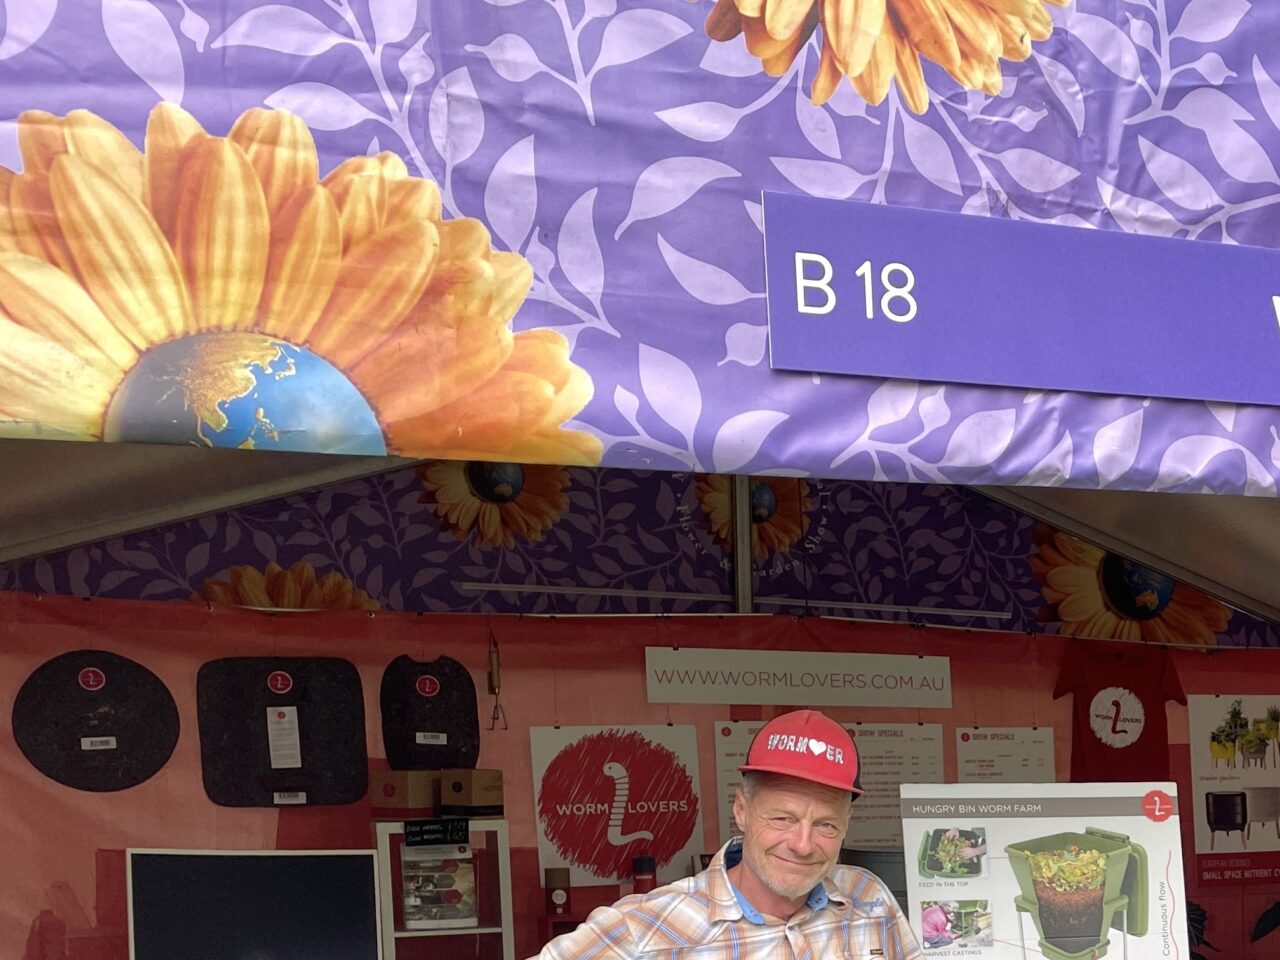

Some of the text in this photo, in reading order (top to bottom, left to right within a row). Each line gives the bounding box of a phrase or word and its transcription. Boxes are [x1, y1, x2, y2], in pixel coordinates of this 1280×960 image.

[794, 251, 918, 323] B 18
[653, 668, 945, 692] WWW.WORMLOVERS.COM.AU
[556, 801, 689, 815] WORM LOVERS
[912, 804, 1041, 814] HUNGRY BIN WORM FARM
[1158, 881, 1171, 957] Continuous flow
